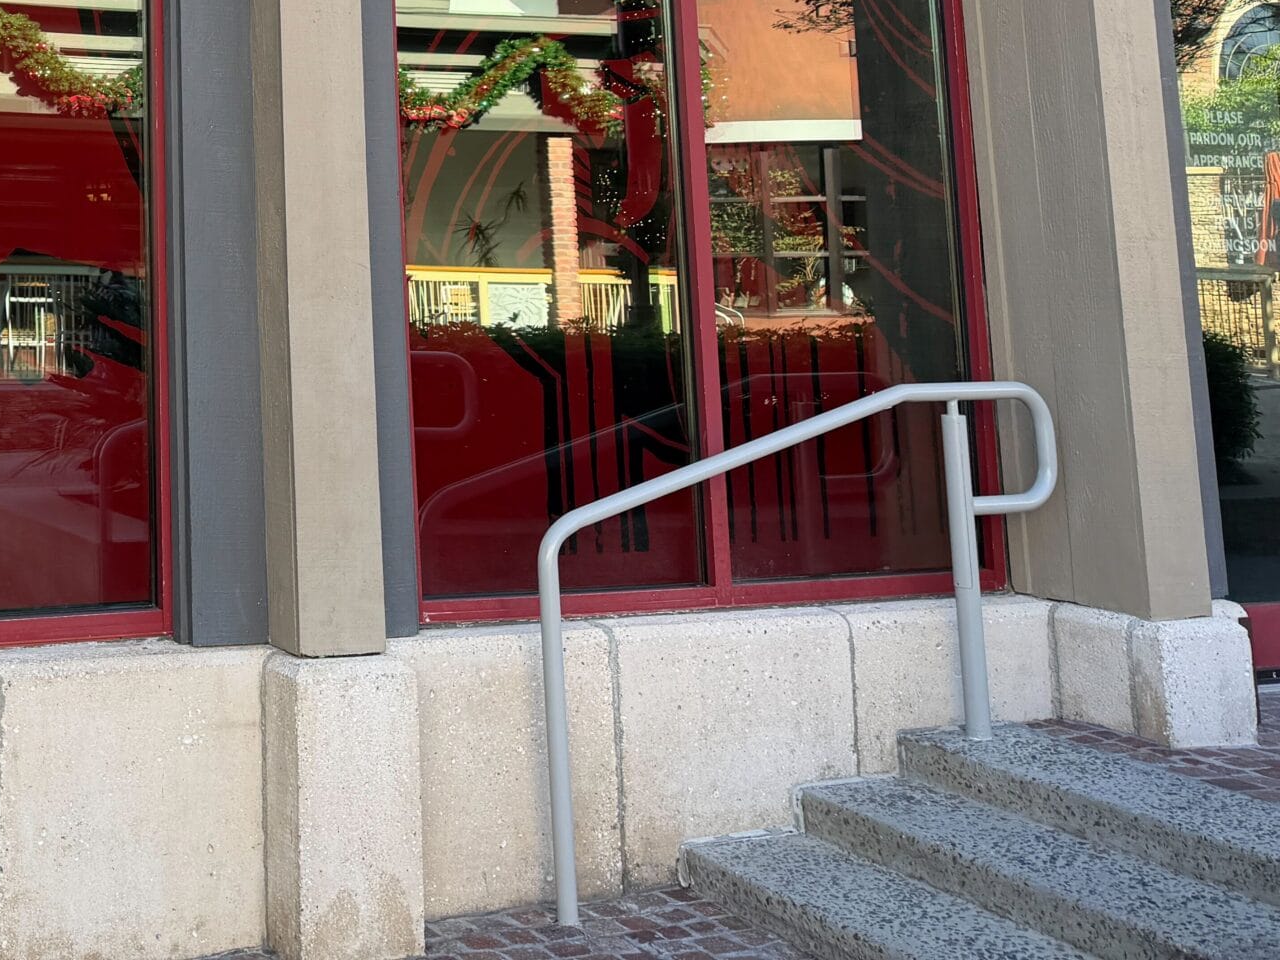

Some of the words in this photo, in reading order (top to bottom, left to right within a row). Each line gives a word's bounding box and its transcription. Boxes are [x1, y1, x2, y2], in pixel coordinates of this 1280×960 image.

[1204, 110, 1244, 124] PLEASE
[1190, 132, 1234, 146] PARDON
[1238, 133, 1262, 147] OUR
[1193, 154, 1264, 168] APPEARANCE
[1244, 238, 1277, 252] SOON
